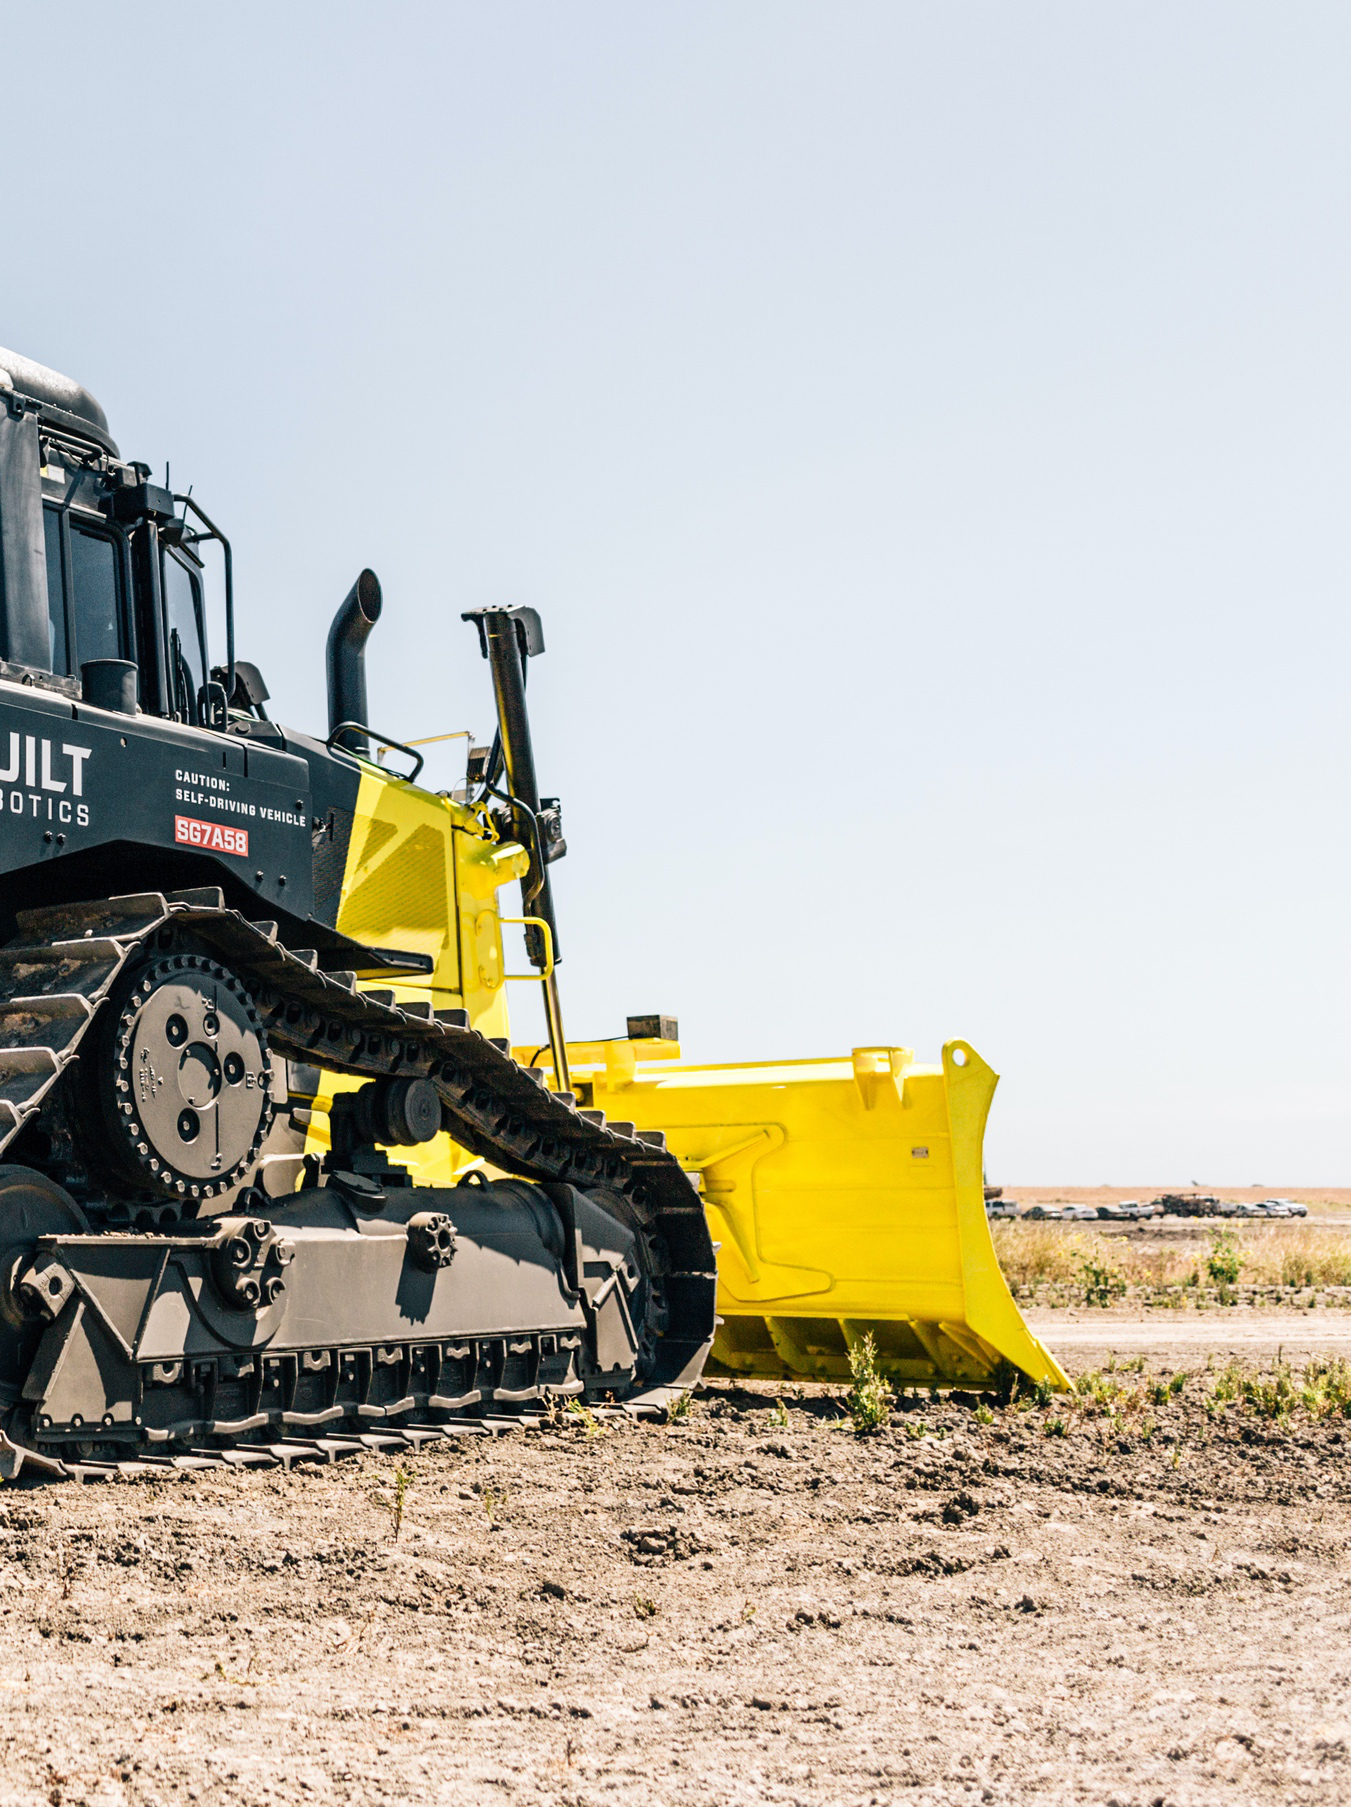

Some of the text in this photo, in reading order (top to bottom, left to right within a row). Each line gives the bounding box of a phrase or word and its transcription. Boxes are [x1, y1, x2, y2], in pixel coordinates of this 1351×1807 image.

[175, 769, 231, 792] CAUTION:
[175, 788, 307, 827] SELF-DRIVING VEHICLE
[176, 818, 248, 855] SG7A58
